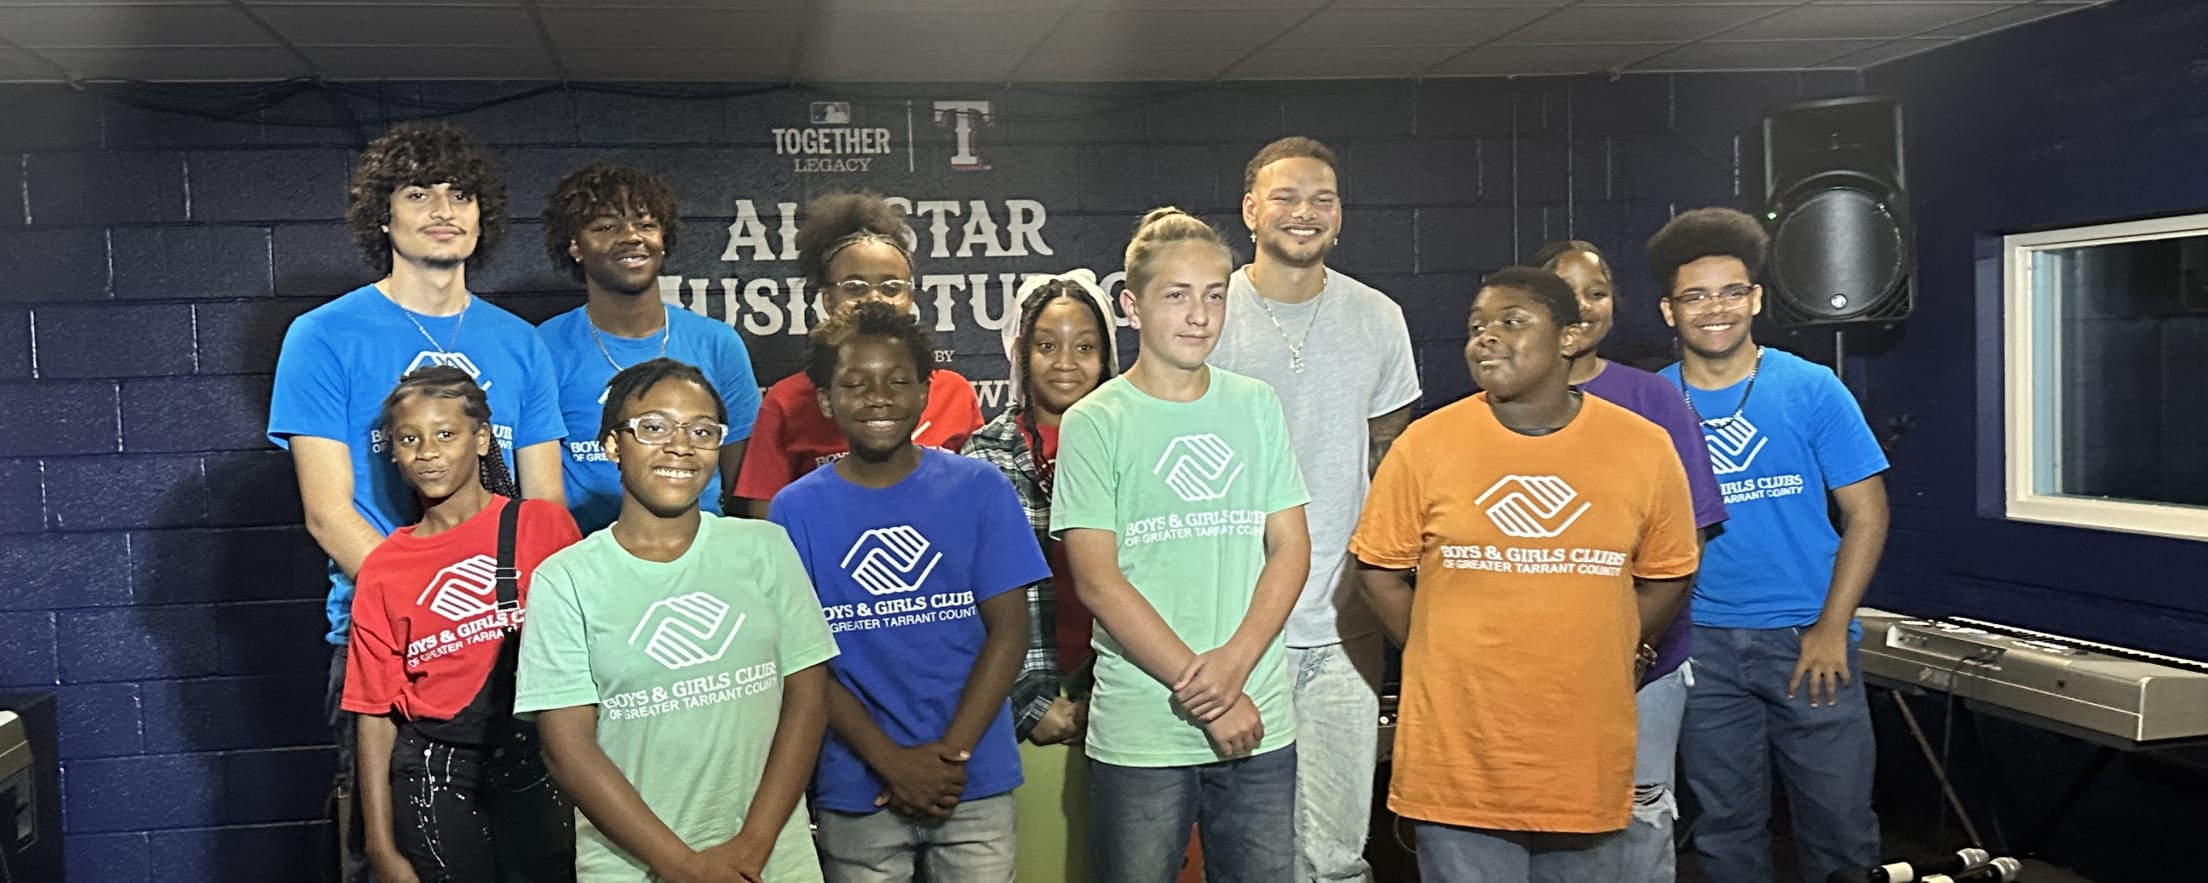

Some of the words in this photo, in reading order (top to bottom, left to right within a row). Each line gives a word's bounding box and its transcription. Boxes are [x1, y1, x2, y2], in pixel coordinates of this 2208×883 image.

[772, 127, 891, 155] TOGETHER
[793, 158, 872, 173] LEGACY
[721, 199, 801, 261] AL
[934, 350, 955, 362] BY
[1719, 479, 1755, 496] IRLS
[1757, 474, 1803, 488] CLUBS
[1723, 490, 1765, 504] ARRANT
[1125, 516, 1166, 537] BOYS
[1168, 514, 1183, 528] &
[1185, 510, 1229, 526] GIRLS
[1125, 537, 1141, 547] OF
[1142, 527, 1192, 544] GREATER
[1440, 545, 1481, 559] BOYS
[1485, 545, 1503, 561] &
[1506, 547, 1566, 563] GIRLS
[1570, 548, 1627, 566] CLUBS
[1456, 560, 1512, 573] GREATER
[1515, 563, 1576, 575] TARRANT
[822, 604, 854, 621] OYS
[857, 602, 872, 617] &
[874, 596, 927, 615] GIRLS
[930, 591, 974, 609] CLUB
[831, 619, 880, 633] GREATER
[883, 612, 937, 628] TARRANT
[938, 606, 976, 621] COUNT
[407, 634, 438, 658] OYS
[440, 629, 457, 644] &
[457, 613, 508, 638] GIRLS
[466, 629, 506, 645] TARRA
[602, 690, 649, 710] BOYS
[652, 686, 669, 703] &
[672, 671, 731, 698] GIRLS
[609, 709, 622, 720] OF
[625, 700, 680, 720] GREATER
[682, 687, 742, 710] TARRANT
